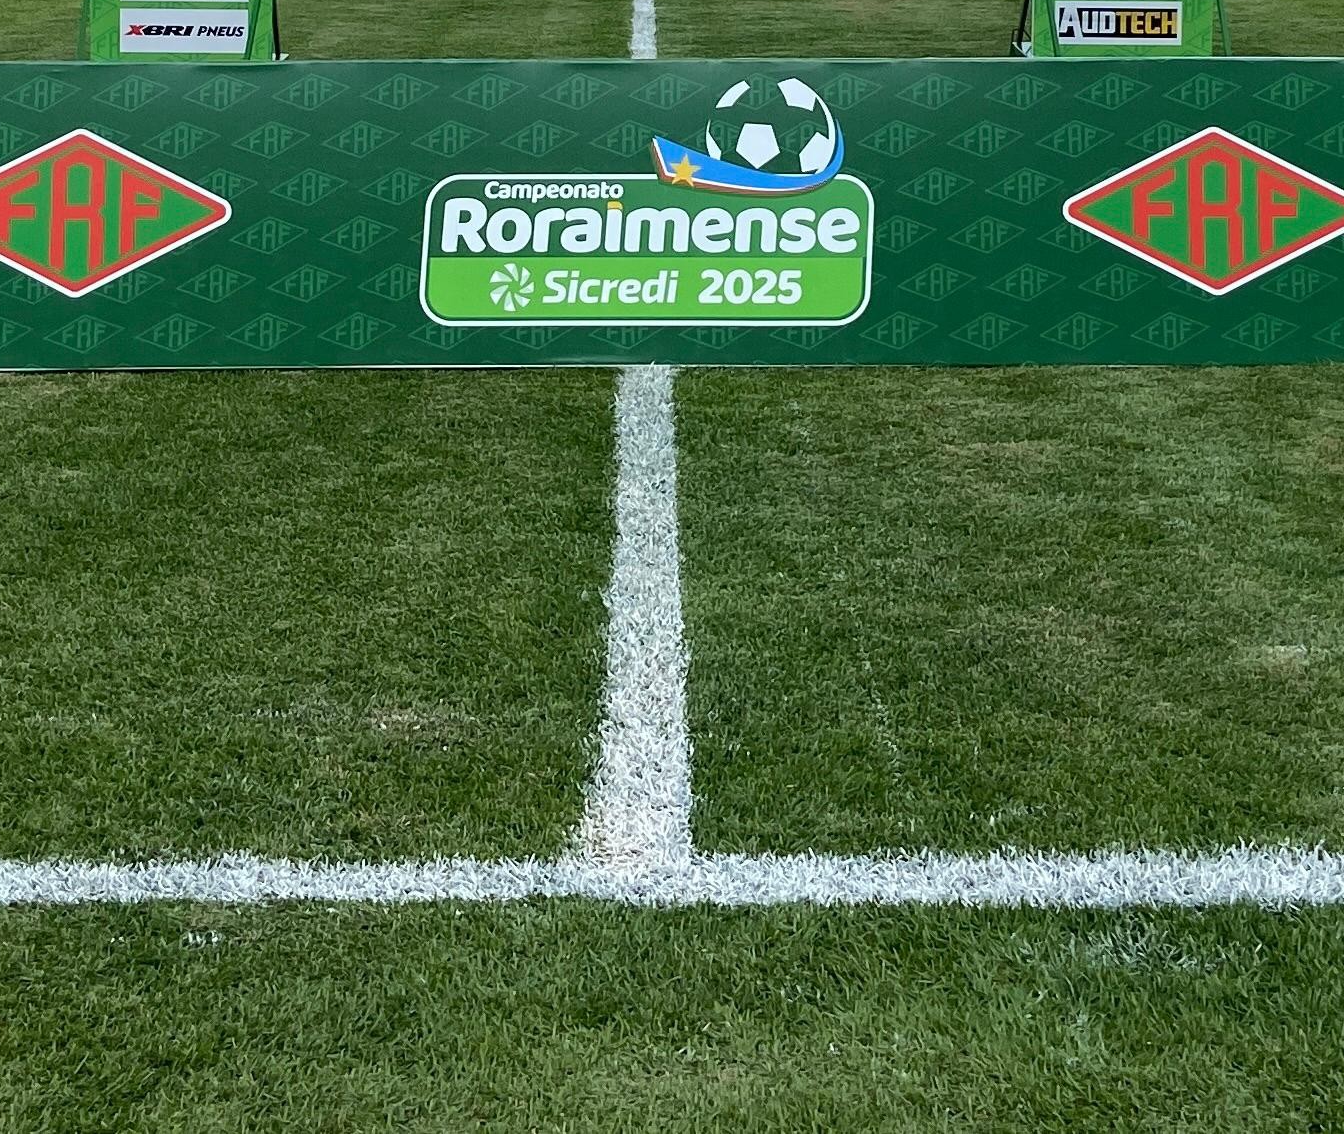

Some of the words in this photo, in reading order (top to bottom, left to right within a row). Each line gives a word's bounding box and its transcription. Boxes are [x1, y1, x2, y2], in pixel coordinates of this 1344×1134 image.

[124, 24, 195, 38] XBRI
[197, 25, 245, 38] PNEUS
[1059, 2, 1178, 36] AUDTECH
[484, 180, 624, 204] Campeonato
[440, 196, 861, 254] Roraimense
[542, 269, 679, 305] Sicredi
[698, 268, 804, 305] 2025
